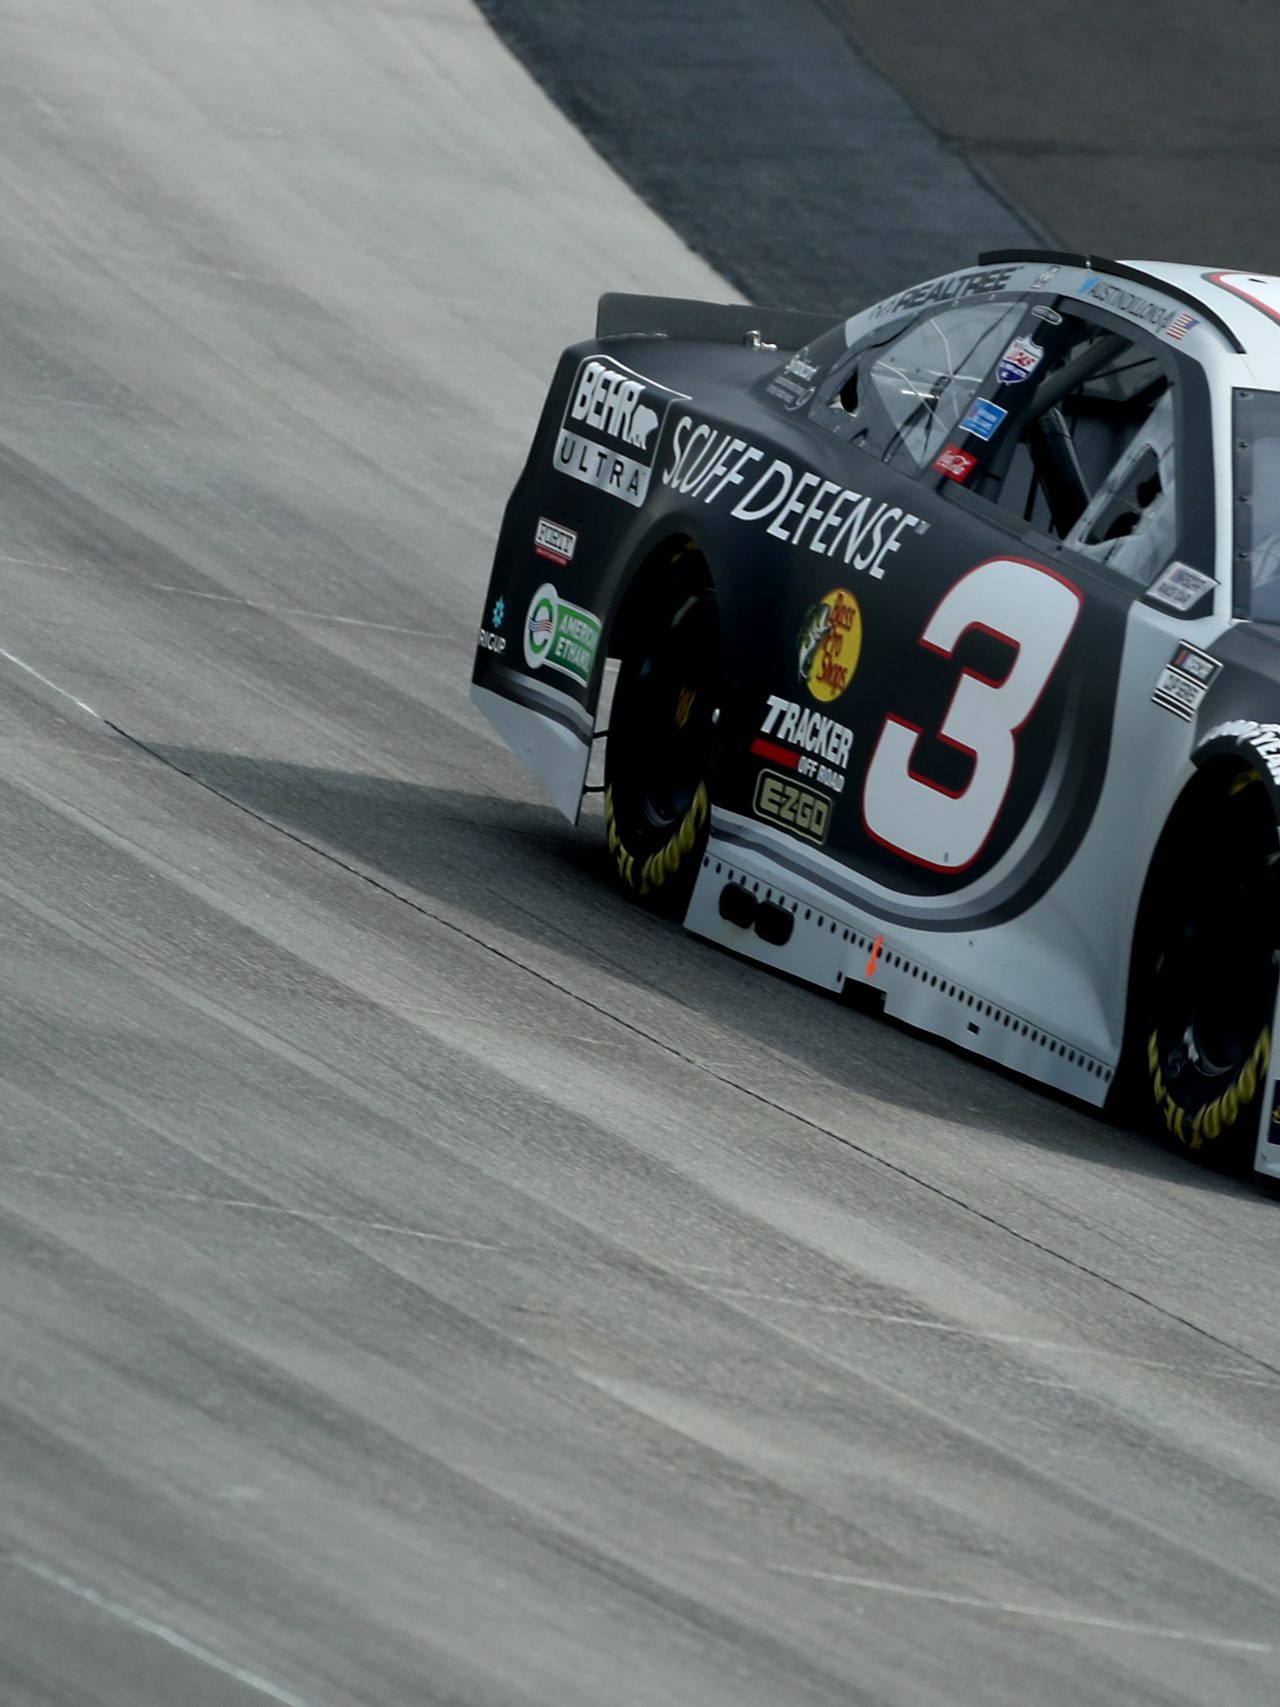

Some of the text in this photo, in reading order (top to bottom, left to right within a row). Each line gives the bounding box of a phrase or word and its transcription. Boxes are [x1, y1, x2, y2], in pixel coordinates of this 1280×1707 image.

[892, 266, 1017, 312] REALTREE
[571, 361, 646, 441] BEHR
[560, 437, 640, 496] ULTRA
[662, 415, 919, 580] SCUFF DEFENSE
[760, 695, 854, 769] TRACKER
[863, 555, 1084, 875] 3
[797, 755, 845, 793] OFF ROAD
